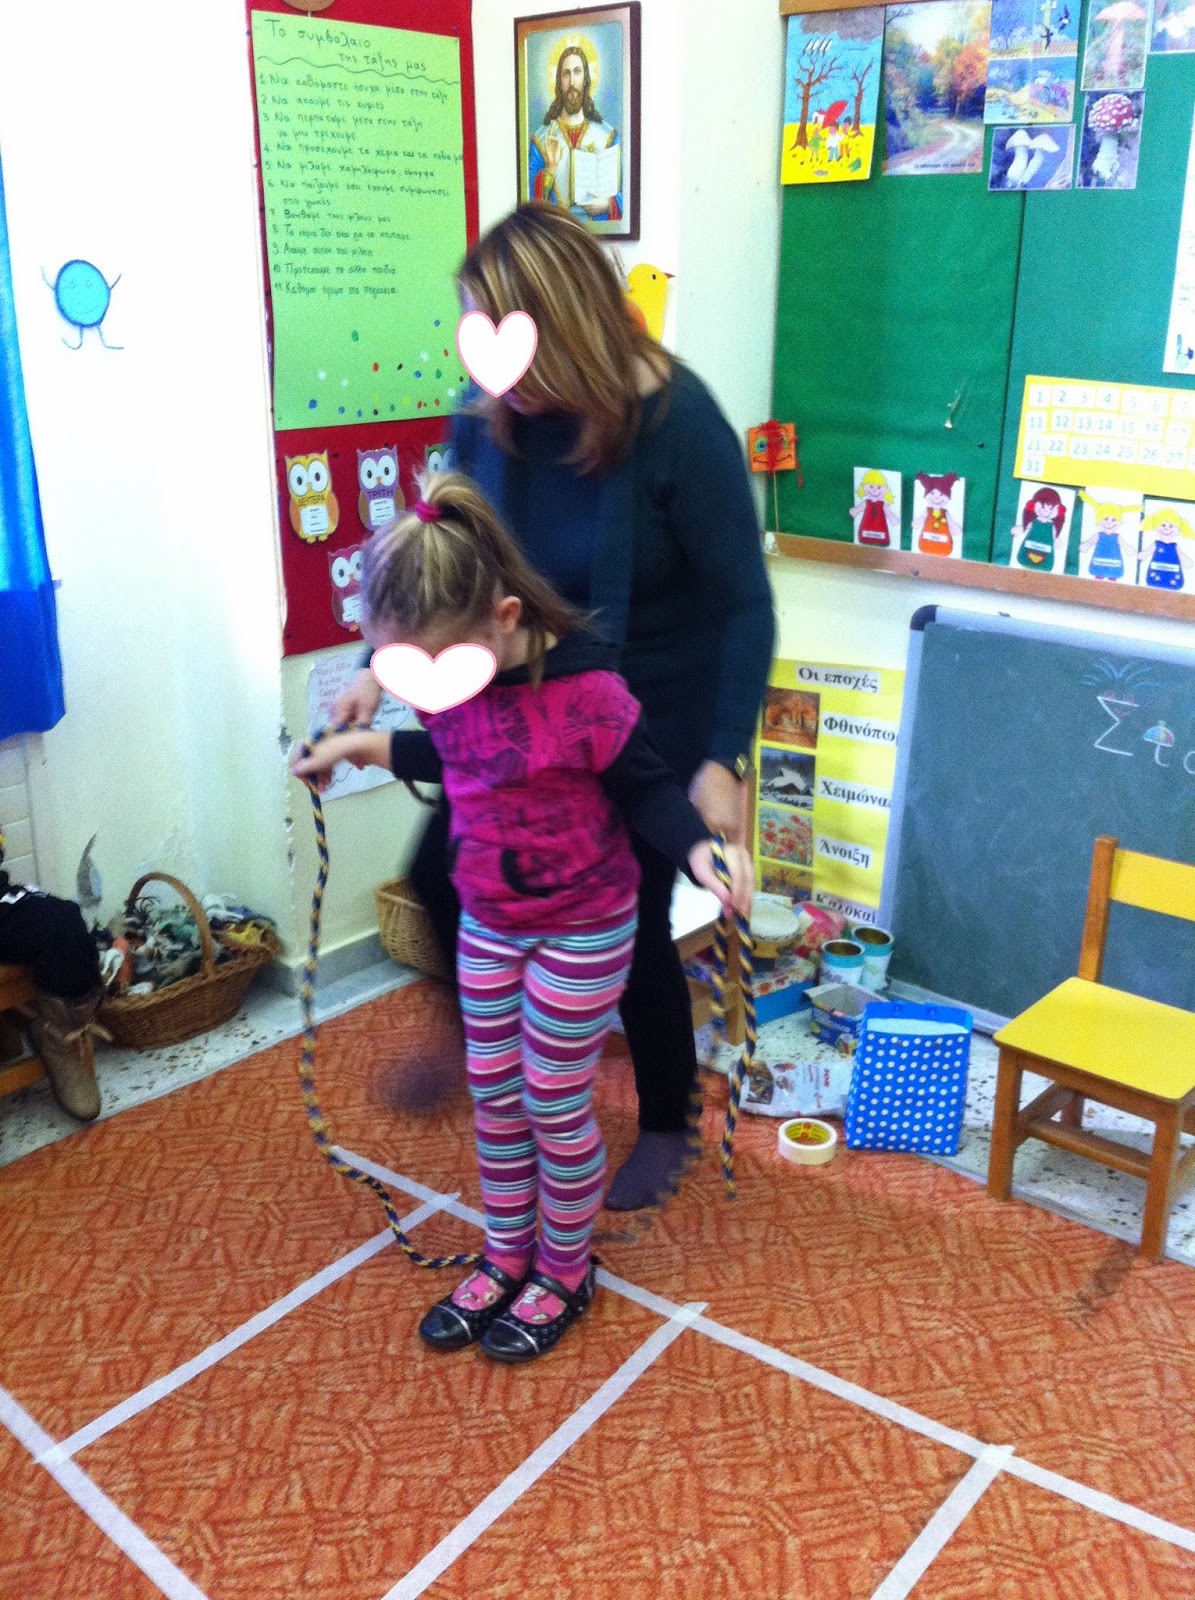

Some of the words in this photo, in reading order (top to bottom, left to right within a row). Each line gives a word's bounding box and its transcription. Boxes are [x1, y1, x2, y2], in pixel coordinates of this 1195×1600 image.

[265, 19, 286, 37] Το
[1037, 391, 1042, 402] 1
[1058, 390, 1066, 402] 2
[1081, 393, 1088, 403] 3
[1104, 393, 1112, 404] 4
[1030, 417, 1042, 428] 11
[1056, 416, 1069, 427] 12
[1078, 418, 1092, 430] 13
[1099, 419, 1112, 430] 14
[1028, 440, 1041, 451] 21
[1050, 440, 1063, 451] 22
[1073, 443, 1088, 455] 23
[1096, 444, 1110, 455] 24
[1027, 460, 1039, 472] 31
[799, 667, 818, 681] Οι
[824, 673, 878, 693] εποχές
[820, 839, 870, 868] Άνοιξη
